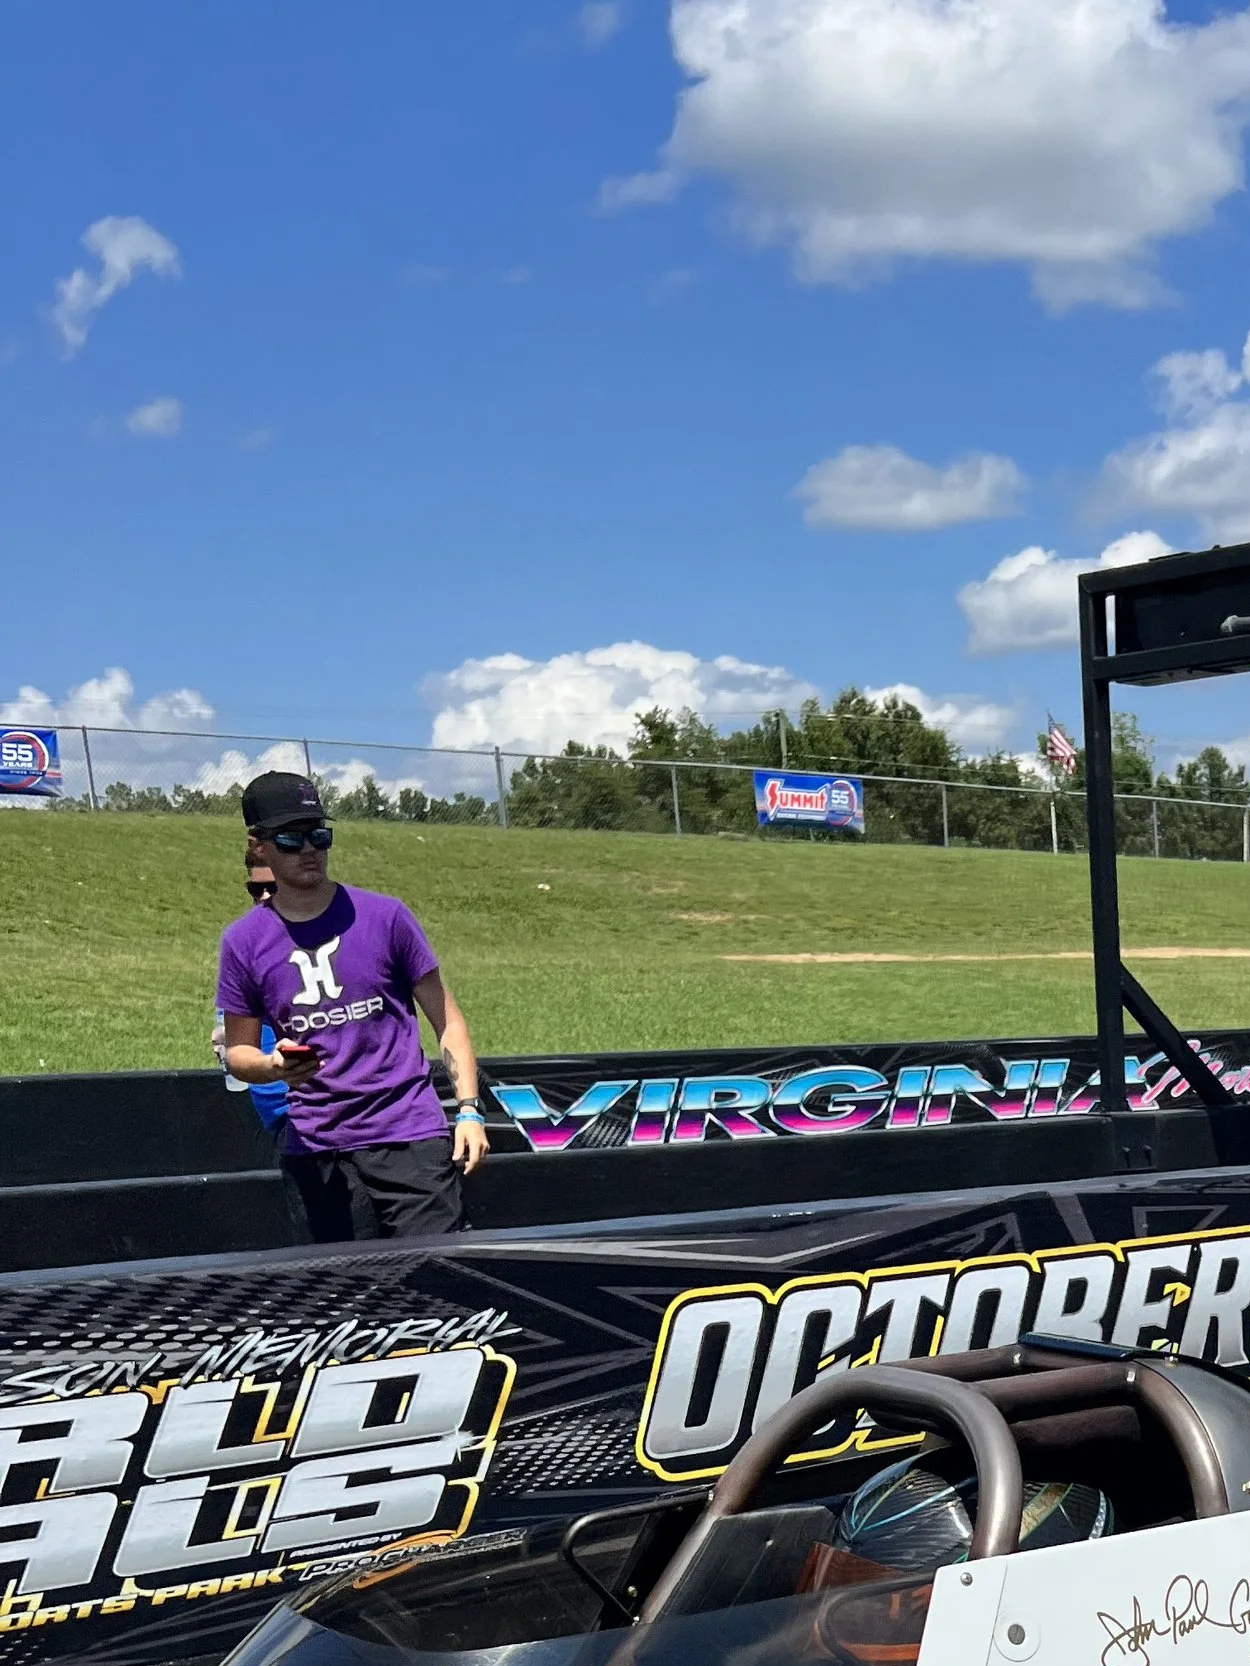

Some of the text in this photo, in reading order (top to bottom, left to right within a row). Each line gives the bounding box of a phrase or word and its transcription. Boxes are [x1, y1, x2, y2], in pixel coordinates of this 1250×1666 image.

[2, 742, 34, 762] 55
[831, 789, 849, 804] 55
[277, 996, 384, 1033] HOOSIER
[490, 1056, 1160, 1152] VIRGINIA
[181, 1307, 523, 1391] MEMORIAL
[151, 1565, 288, 1606] PARK
